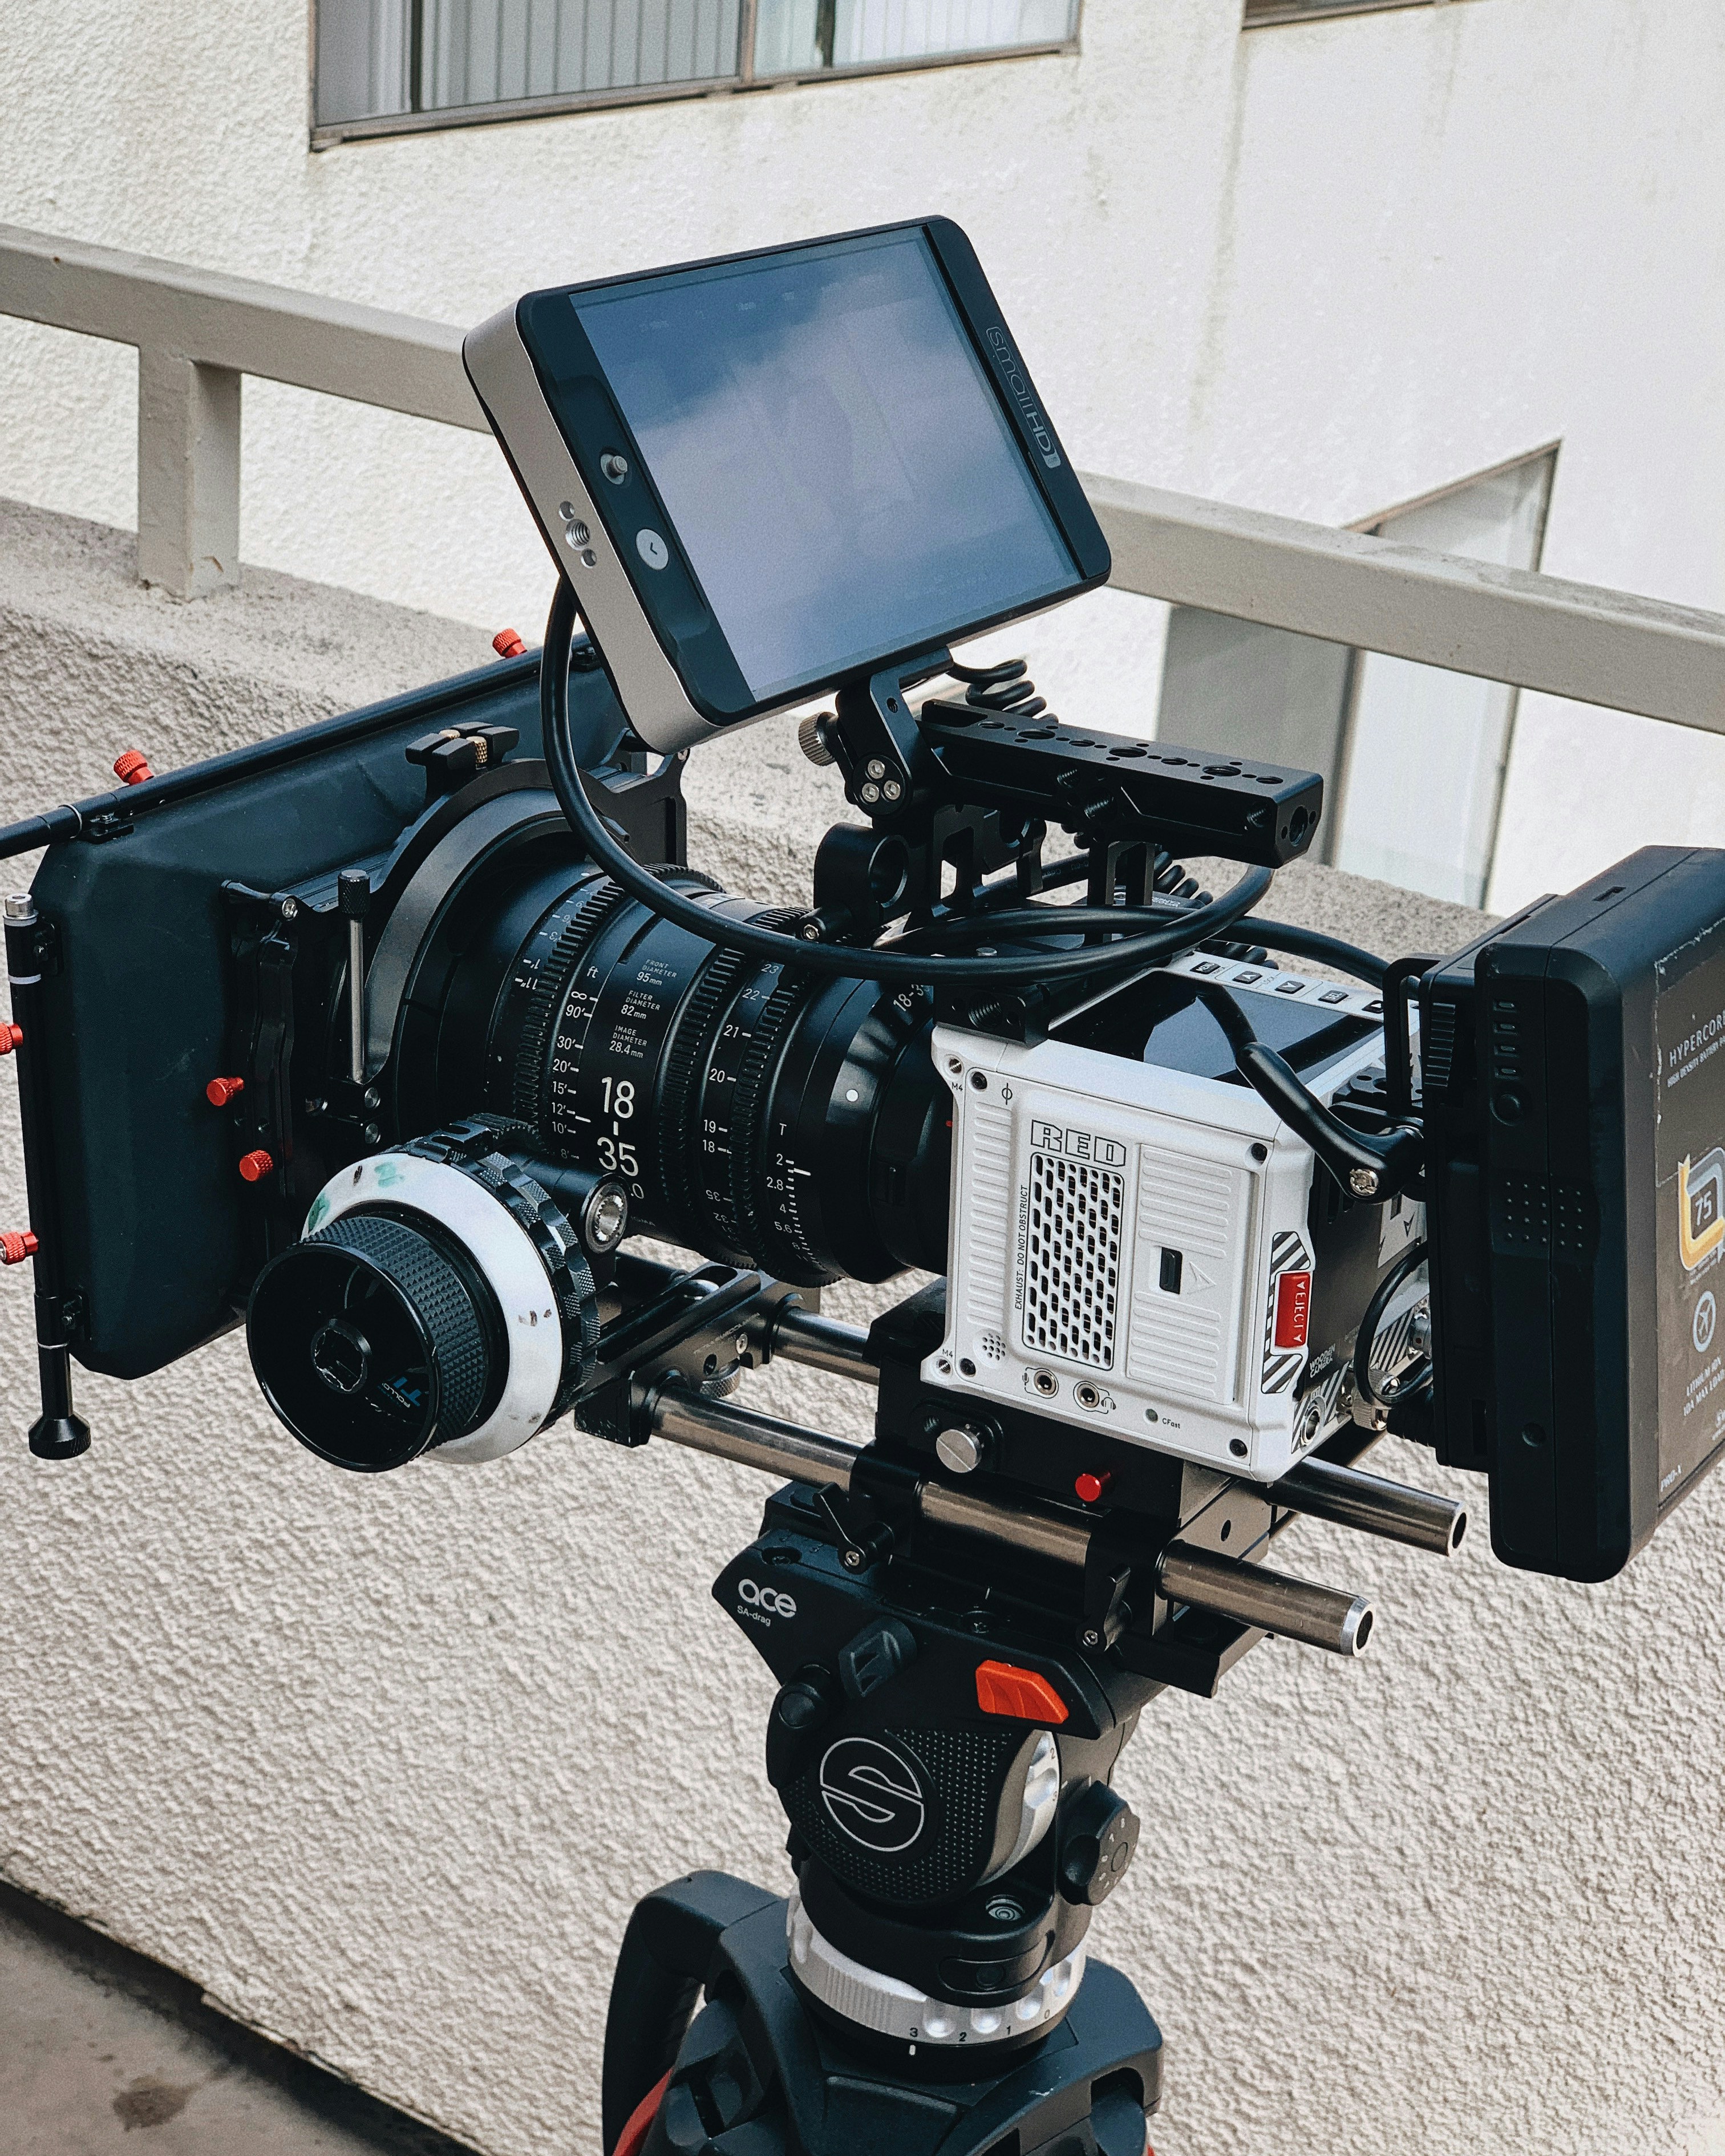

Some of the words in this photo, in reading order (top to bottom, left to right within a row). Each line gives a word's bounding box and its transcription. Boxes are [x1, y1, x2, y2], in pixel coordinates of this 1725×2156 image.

[990, 331, 1051, 452] smallHD
[645, 959, 669, 968] FRONT
[761, 963, 779, 974] 23
[587, 966, 598, 978] ft
[642, 965, 677, 978] DIAMETER
[628, 990, 653, 1002] FILTER
[742, 988, 760, 1000] 22
[893, 984, 924, 1011] 18-3
[625, 996, 661, 1011] DIAMETER
[615, 1024, 637, 1036] IMAGE
[723, 1024, 739, 1038] 21
[612, 1032, 647, 1047] DIAMETER
[709, 1068, 726, 1083] 20
[951, 1082, 963, 1092] M4
[602, 1077, 635, 1118] 18
[703, 1119, 716, 1133] 19
[779, 1122, 787, 1136] T
[702, 1139, 715, 1153] 18
[1030, 1119, 1127, 1167] RED
[597, 1137, 639, 1177] 35
[776, 1153, 783, 1166] 2
[766, 1176, 784, 1191] 2.8
[779, 1203, 787, 1214] 4
[1019, 1185, 1028, 1231] OBSTRUCT
[1695, 1190, 1712, 1226] 75
[774, 1221, 792, 1233] 5.6
[1017, 1251, 1025, 1265] DO
[1015, 1270, 1025, 1310] EXHAUST:
[1293, 1292, 1306, 1329] EJECT
[942, 1348, 953, 1357] M4
[381, 1383, 411, 1408] FOLLO
[1162, 1418, 1180, 1429] CFast
[738, 1579, 796, 1618] ace
[737, 1605, 771, 1627] SA-drag
[909, 2027, 918, 2037] 3
[959, 2032, 967, 2042] 2
[1006, 2025, 1011, 2035] 1
[1044, 2009, 1050, 2019] 0
